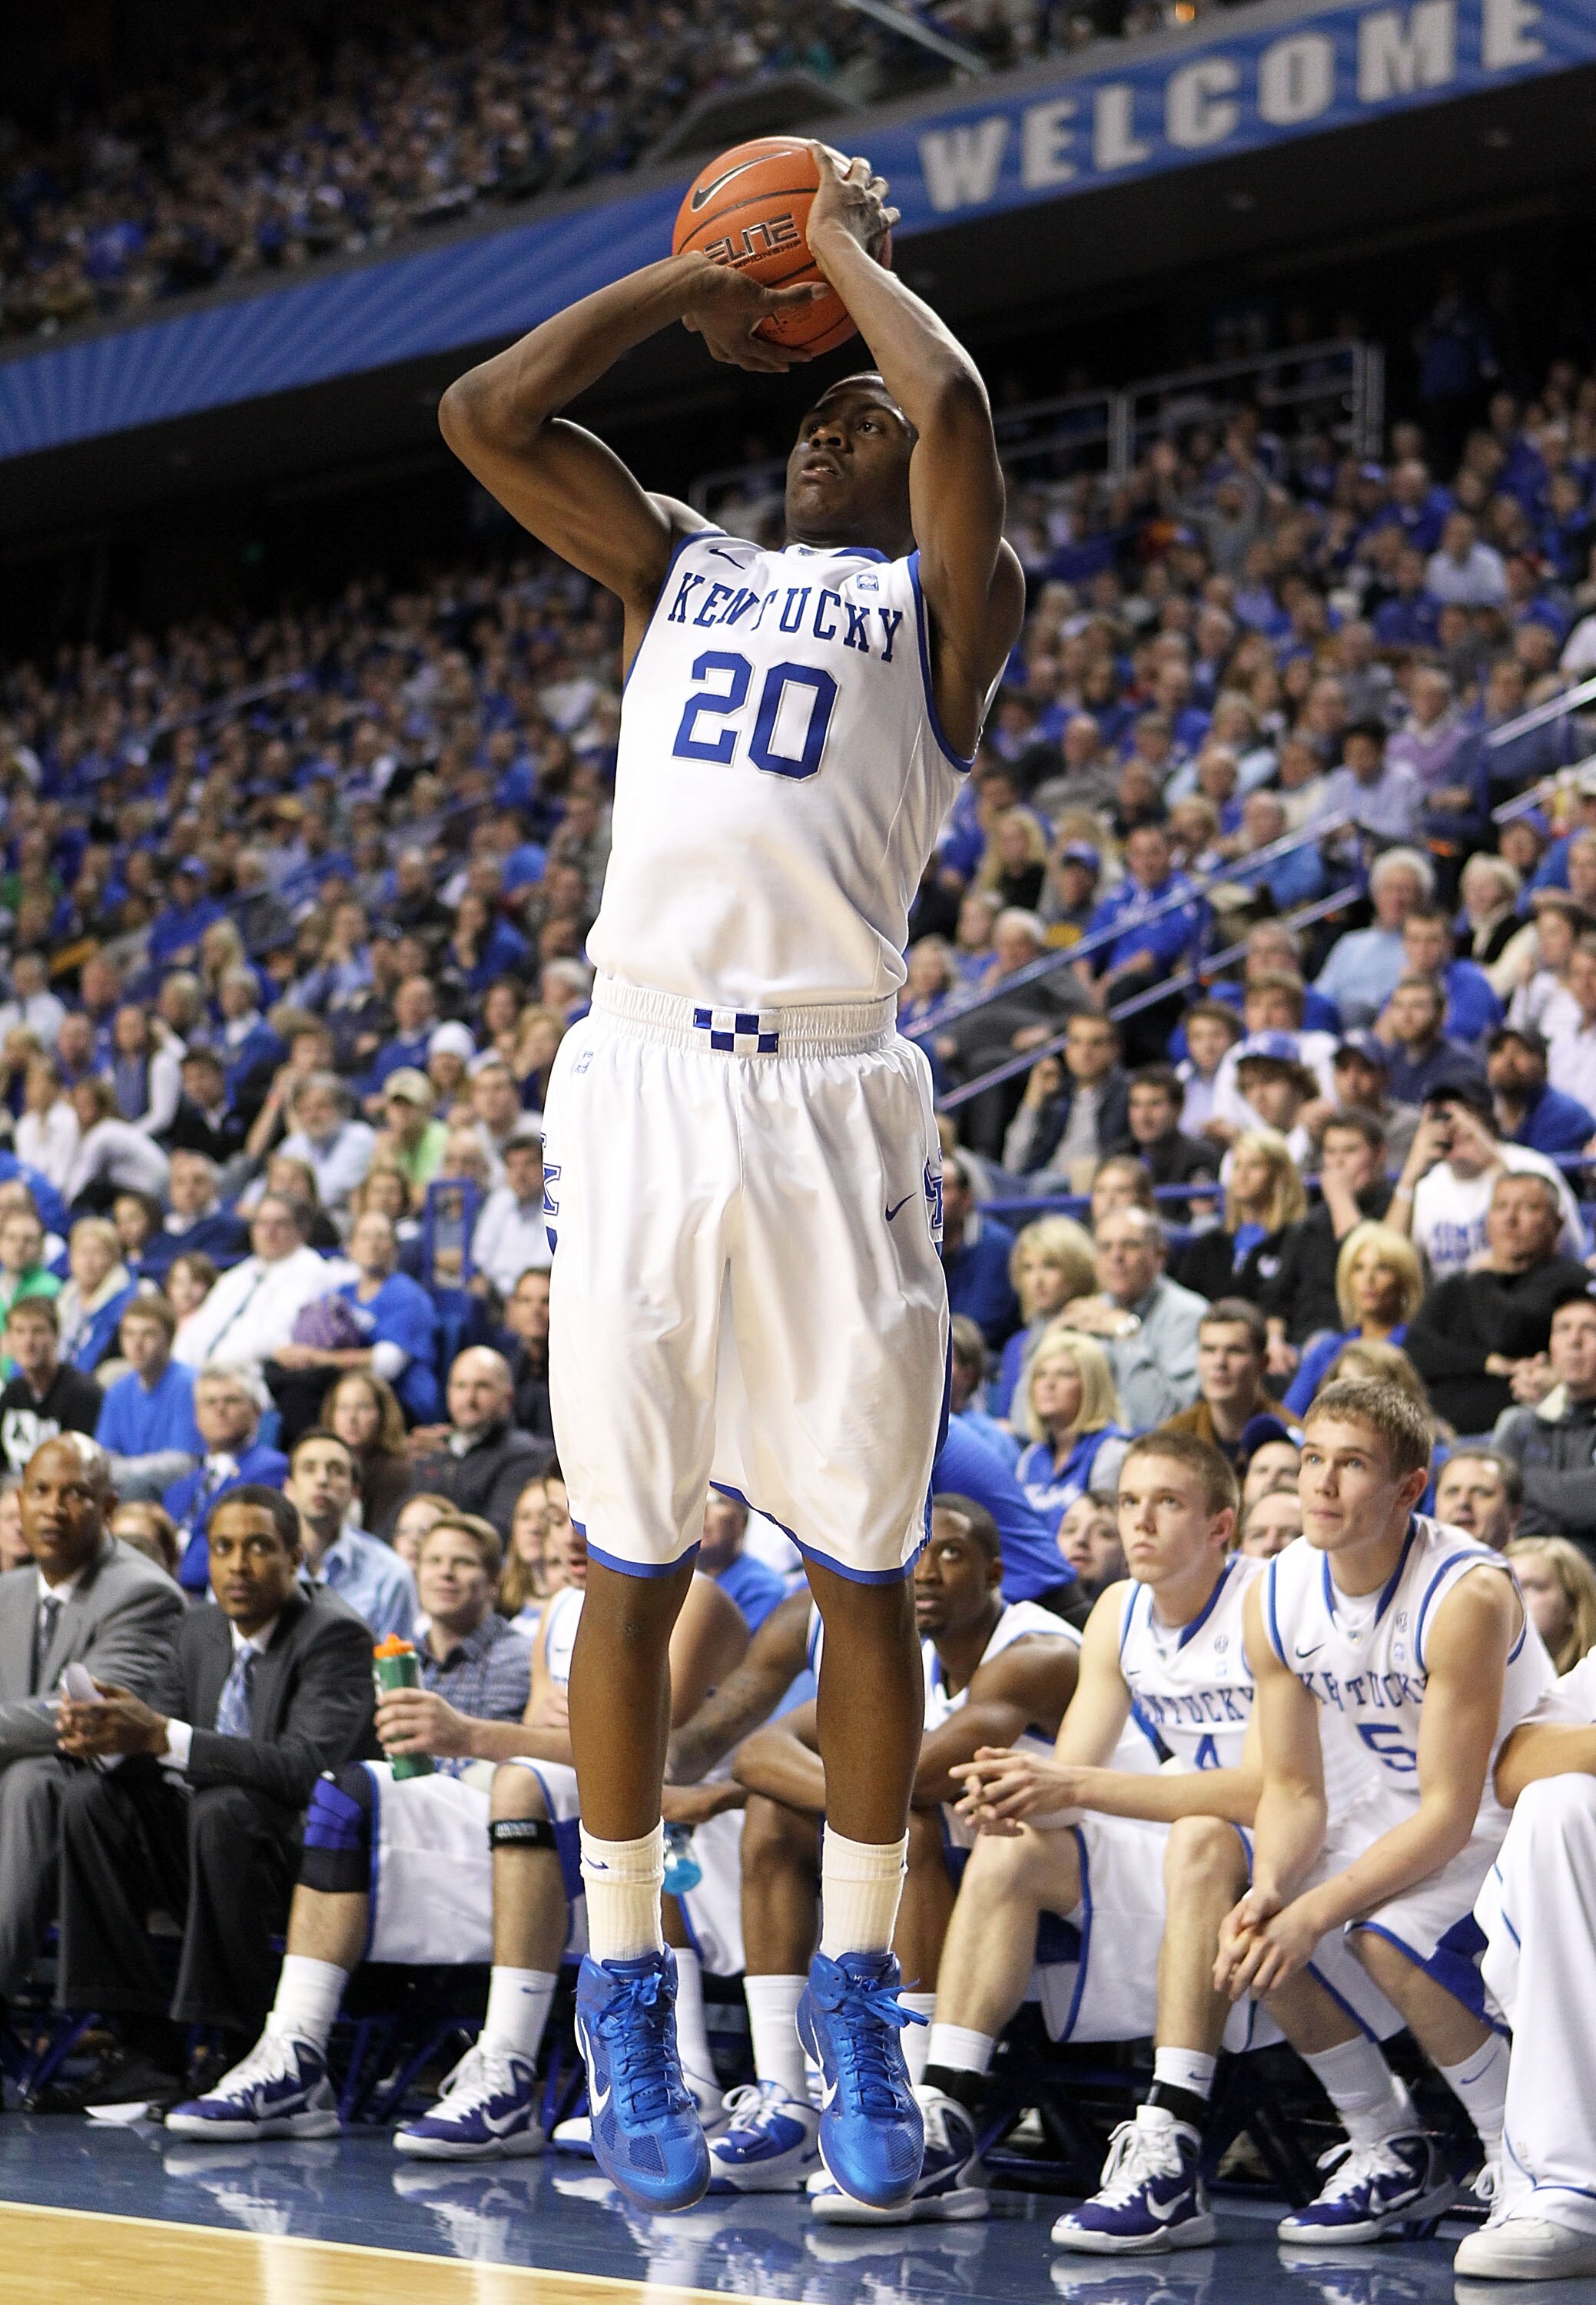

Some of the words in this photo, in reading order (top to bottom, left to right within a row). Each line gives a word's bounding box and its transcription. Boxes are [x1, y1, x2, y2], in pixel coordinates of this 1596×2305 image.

[919, 0, 1545, 213] WELCOME
[704, 211, 800, 265] ELITE
[667, 572, 903, 662] KENTUCKY
[671, 649, 841, 781] 20
[1355, 1723, 1417, 1773] 5
